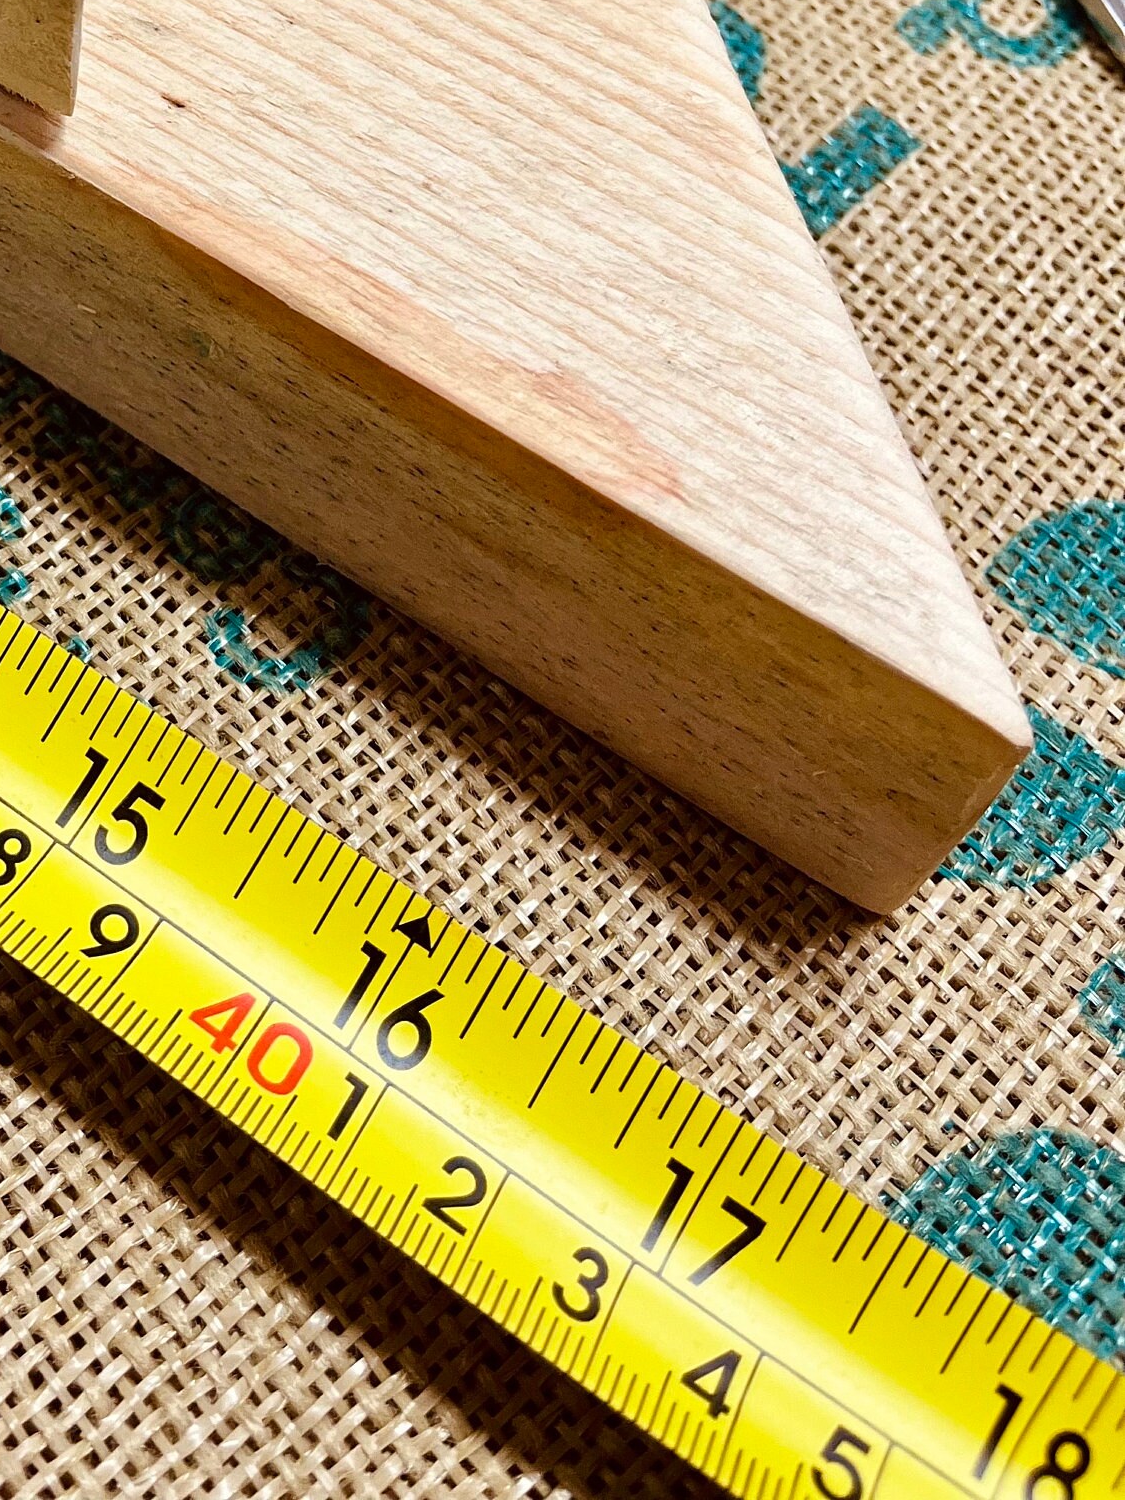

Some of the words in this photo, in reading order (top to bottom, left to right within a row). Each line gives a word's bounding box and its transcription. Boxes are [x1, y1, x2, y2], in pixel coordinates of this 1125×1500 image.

[54, 745, 167, 866] 15
[331, 938, 446, 1071] 16
[637, 1155, 768, 1288] 17
[970, 1382, 1092, 1500] 18
[79, 902, 141, 959] 9
[189, 992, 314, 1097] 40
[327, 1072, 369, 1143] 1
[422, 1155, 488, 1237] 2
[551, 1247, 610, 1323] 3
[682, 1350, 743, 1421] 4
[811, 1427, 871, 1500] 5
